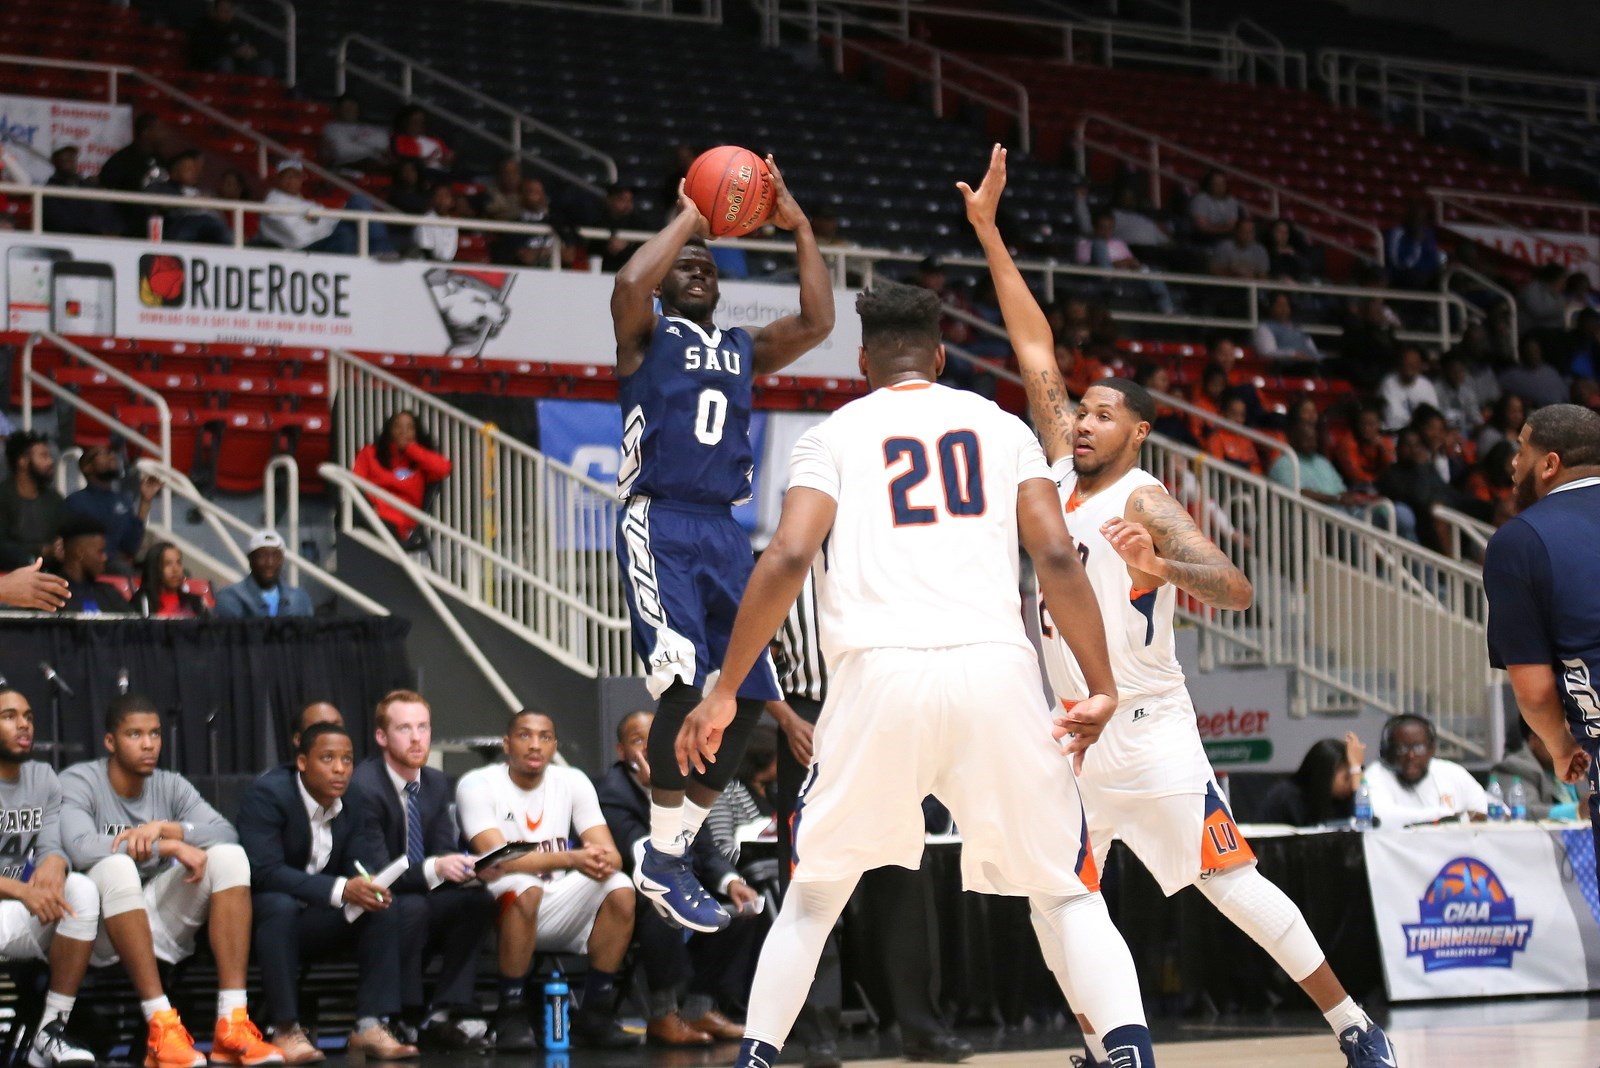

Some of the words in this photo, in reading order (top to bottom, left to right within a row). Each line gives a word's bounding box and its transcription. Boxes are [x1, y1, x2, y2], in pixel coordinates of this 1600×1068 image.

[685, 346, 741, 376] SAU
[694, 388, 728, 446] 0
[881, 428, 988, 528] 20
[1208, 821, 1239, 856] LU
[1443, 901, 1491, 923] CIAA
[1408, 924, 1529, 952] TOURNAMENT
